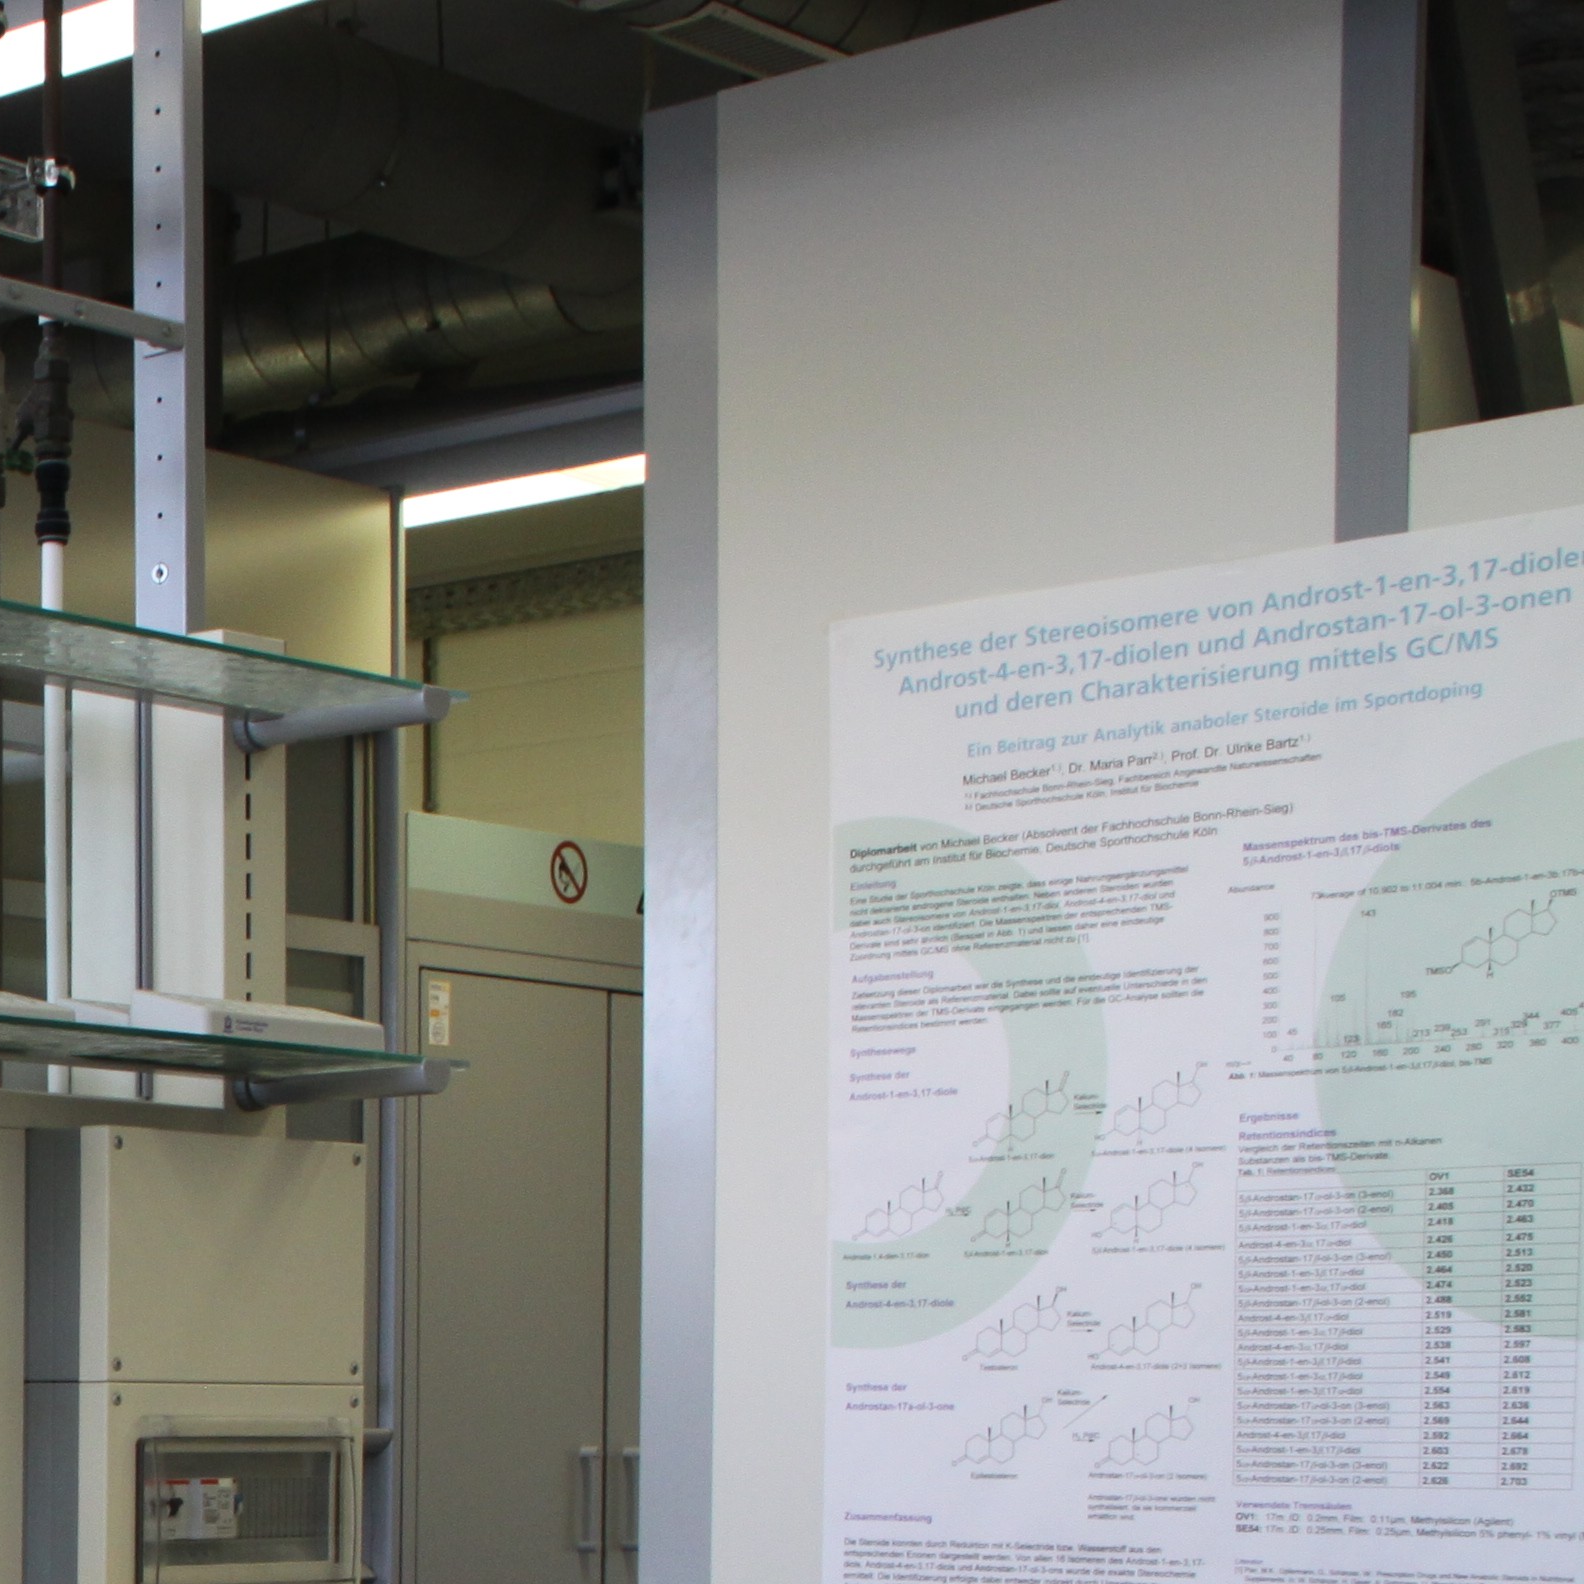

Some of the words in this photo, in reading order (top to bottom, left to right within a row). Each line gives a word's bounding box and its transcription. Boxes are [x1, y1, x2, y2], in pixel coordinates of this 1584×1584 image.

[874, 639, 972, 671] Synthese
[978, 631, 1018, 652] der
[1025, 608, 1200, 646] Stereoisomere
[1207, 599, 1254, 620] von
[1262, 545, 1584, 612] Androst-1-en-3,17-diole
[899, 640, 1190, 694] Androst-4-en-3,17-diolen
[1197, 628, 1246, 655] und
[1253, 586, 1572, 646] Androstan-17-ol-3-onen
[954, 693, 999, 718] und
[1005, 689, 1073, 712] deren
[1080, 658, 1300, 702] Charakterisierung
[1308, 640, 1398, 672] mittels
[1406, 626, 1499, 658] GC/MS
[966, 741, 992, 758] Ein
[996, 735, 1056, 753] Beitrag
[1060, 732, 1088, 746] zur
[1093, 719, 1165, 742] Analytik
[1170, 711, 1249, 733] anaboler
[1254, 699, 1330, 722] Steroide
[1334, 698, 1358, 712] im
[1364, 682, 1484, 710] Sportdoping
[962, 770, 1007, 785] Michael
[1068, 761, 1082, 774] Dr.
[1089, 758, 1123, 771] Maria
[1170, 747, 1198, 761] Prof.
[1203, 745, 1219, 758] Dr.
[1226, 741, 1262, 755] Ulrike
[849, 842, 917, 859] Diplomarbeit
[919, 841, 938, 851] von
[940, 836, 980, 849] Michael
[982, 832, 1019, 845] Becker
[1021, 825, 1078, 841] (Absolvent
[1080, 824, 1098, 834] der
[1100, 813, 1190, 832] Fachhochschule
[1192, 802, 1294, 822] Bonn-Rhein-Sieg)
[1242, 835, 1336, 851] Massenspektrum
[1338, 832, 1359, 842] des
[1469, 818, 1492, 829] des
[849, 857, 912, 873] durchgeführt
[913, 856, 930, 866] am
[932, 852, 966, 864] Institut
[968, 849, 983, 860] für
[1045, 839, 1096, 853] Deutsche
[1099, 829, 1190, 848] Sporthochschule
[1192, 826, 1218, 837] Köln
[849, 879, 897, 891] Einleitung
[851, 970, 934, 984] Aufgabenstellung
[849, 1071, 892, 1083] Synthese
[894, 1070, 910, 1080] der
[1238, 1112, 1300, 1124] Ergebnisse
[1238, 1128, 1337, 1140] Retentionsindices
[1428, 1171, 1450, 1181] OV1
[845, 1280, 889, 1291] Synthese
[890, 1279, 907, 1289] der
[845, 1382, 889, 1393] Synthese
[890, 1382, 907, 1391] der
[843, 1511, 932, 1524] Zusammenfassung
